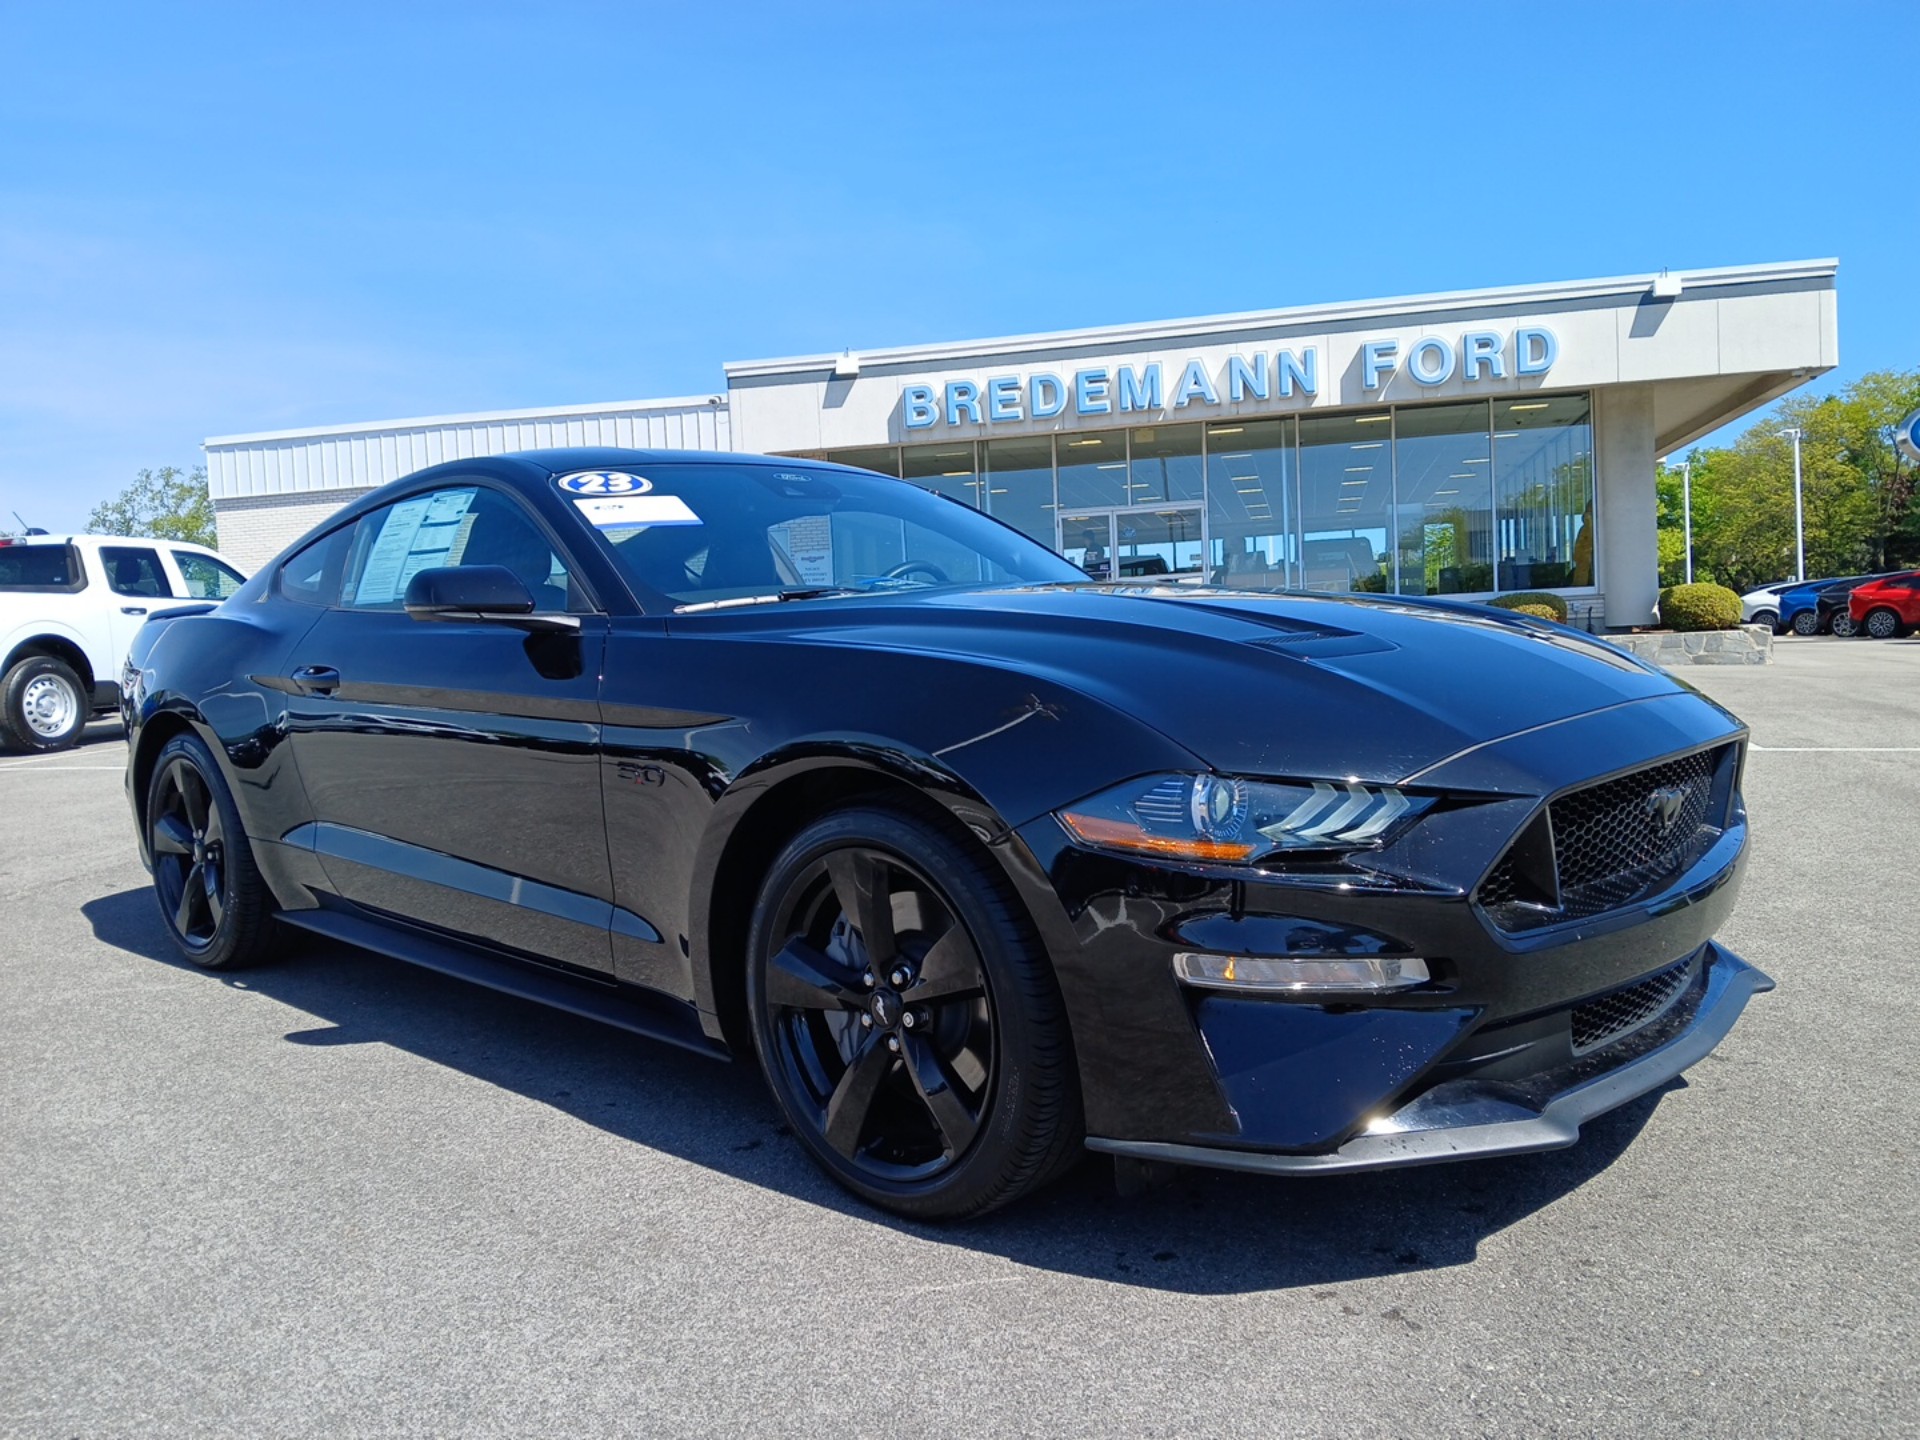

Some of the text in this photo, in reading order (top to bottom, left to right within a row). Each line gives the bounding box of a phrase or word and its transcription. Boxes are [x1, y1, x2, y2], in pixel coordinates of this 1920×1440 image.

[903, 326, 1560, 429] BREDEMANN FORD
[577, 473, 633, 492] 23
